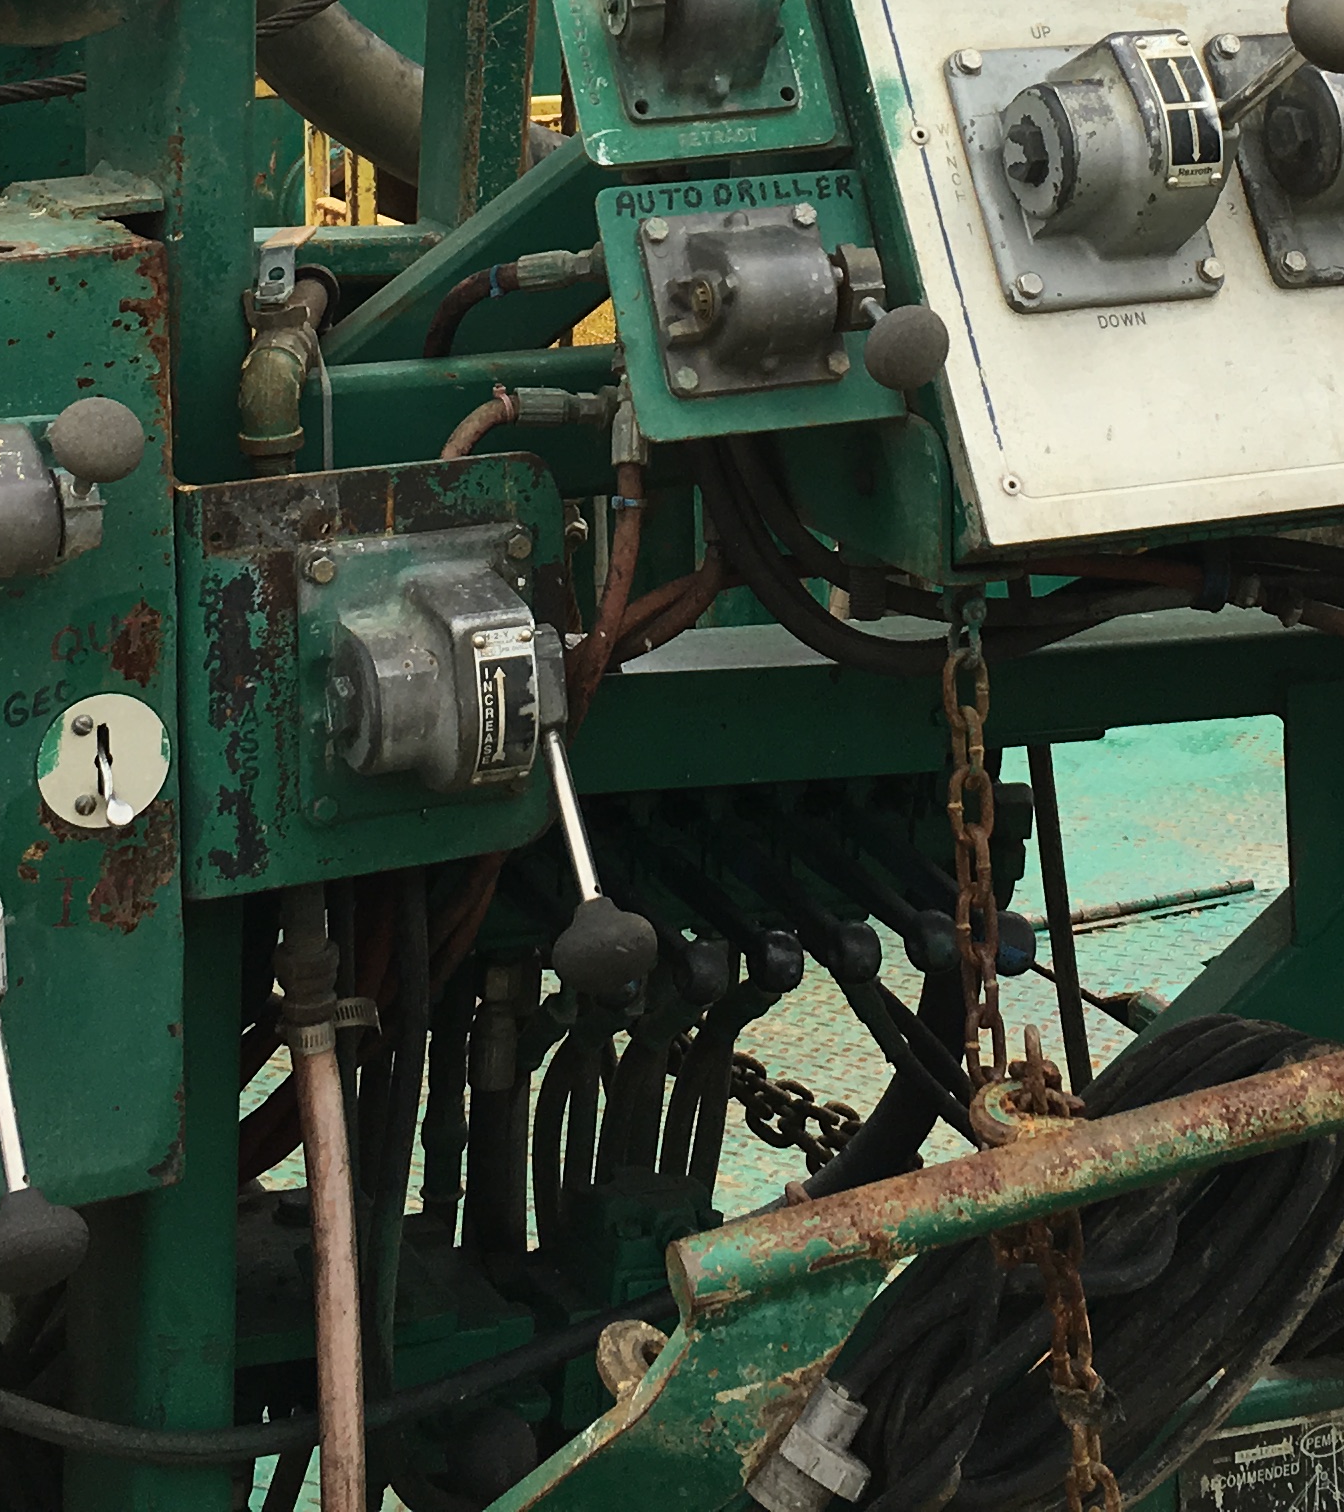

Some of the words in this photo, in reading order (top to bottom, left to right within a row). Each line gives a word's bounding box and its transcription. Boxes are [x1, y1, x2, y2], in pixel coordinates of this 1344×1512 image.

[1030, 25, 1052, 39] UP
[1178, 165, 1213, 177] Rexroth
[616, 186, 704, 218] AUTO
[712, 174, 854, 207] DRILLER
[1097, 312, 1147, 329] DOWN
[481, 667, 495, 765] INCREASE
[1203, 1462, 1300, 1489] COMMENDED
